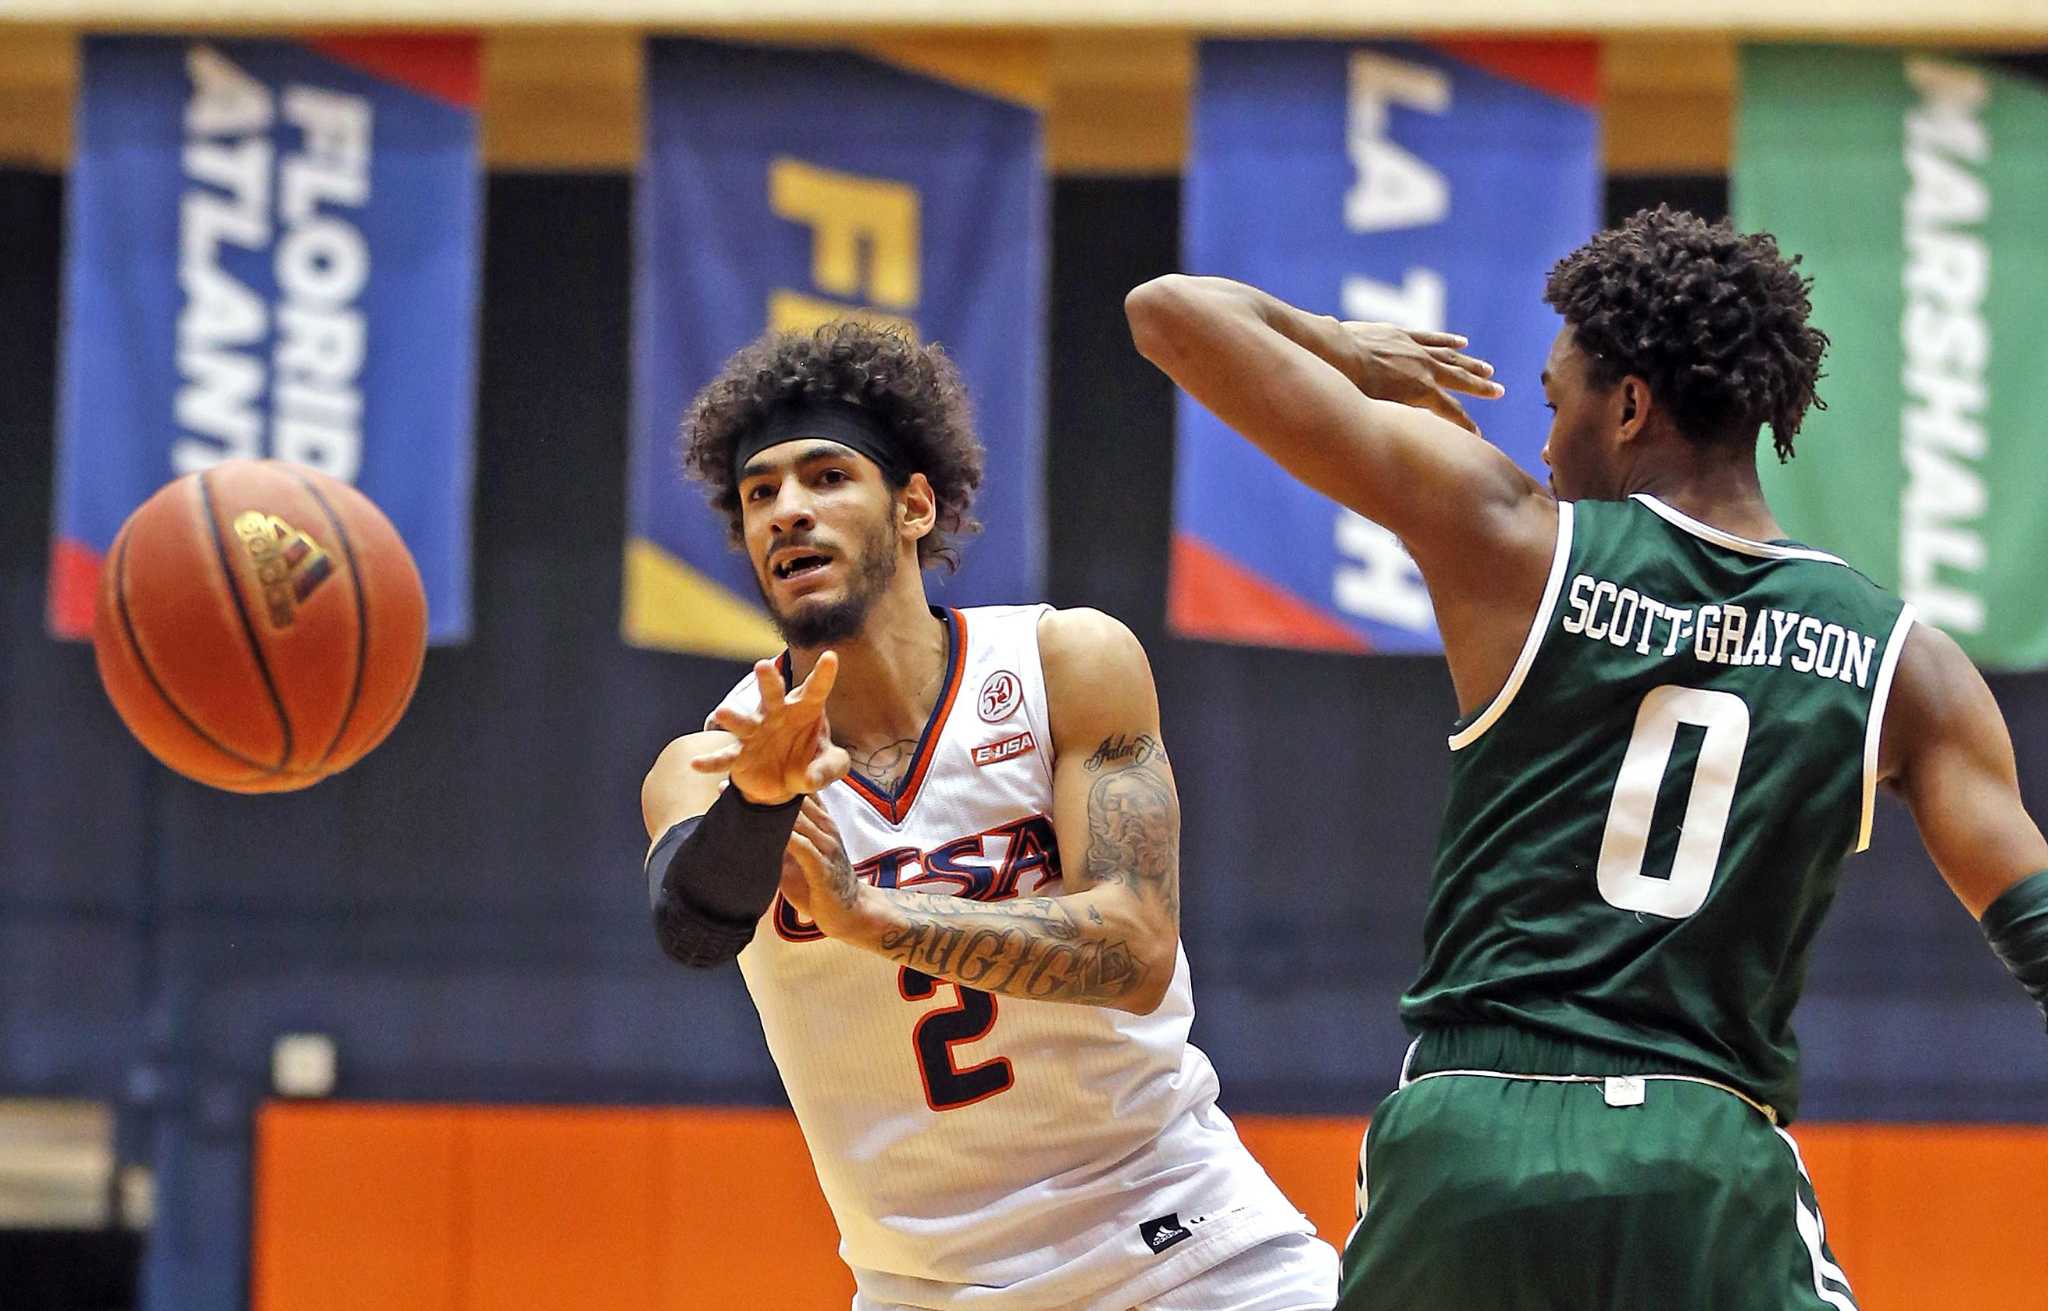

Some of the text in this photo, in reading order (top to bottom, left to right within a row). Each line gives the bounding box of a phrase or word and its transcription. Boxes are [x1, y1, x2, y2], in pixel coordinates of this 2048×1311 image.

[1343, 47, 1452, 233] LA
[172, 42, 274, 476] ATLANT
[272, 84, 373, 487] FLORID
[765, 157, 922, 338] F
[1902, 54, 1989, 634] MARSHALL
[1562, 574, 1877, 689] SCOTT-GRAYSON
[1596, 684, 1750, 919] 0
[897, 964, 1015, 1112] 2
